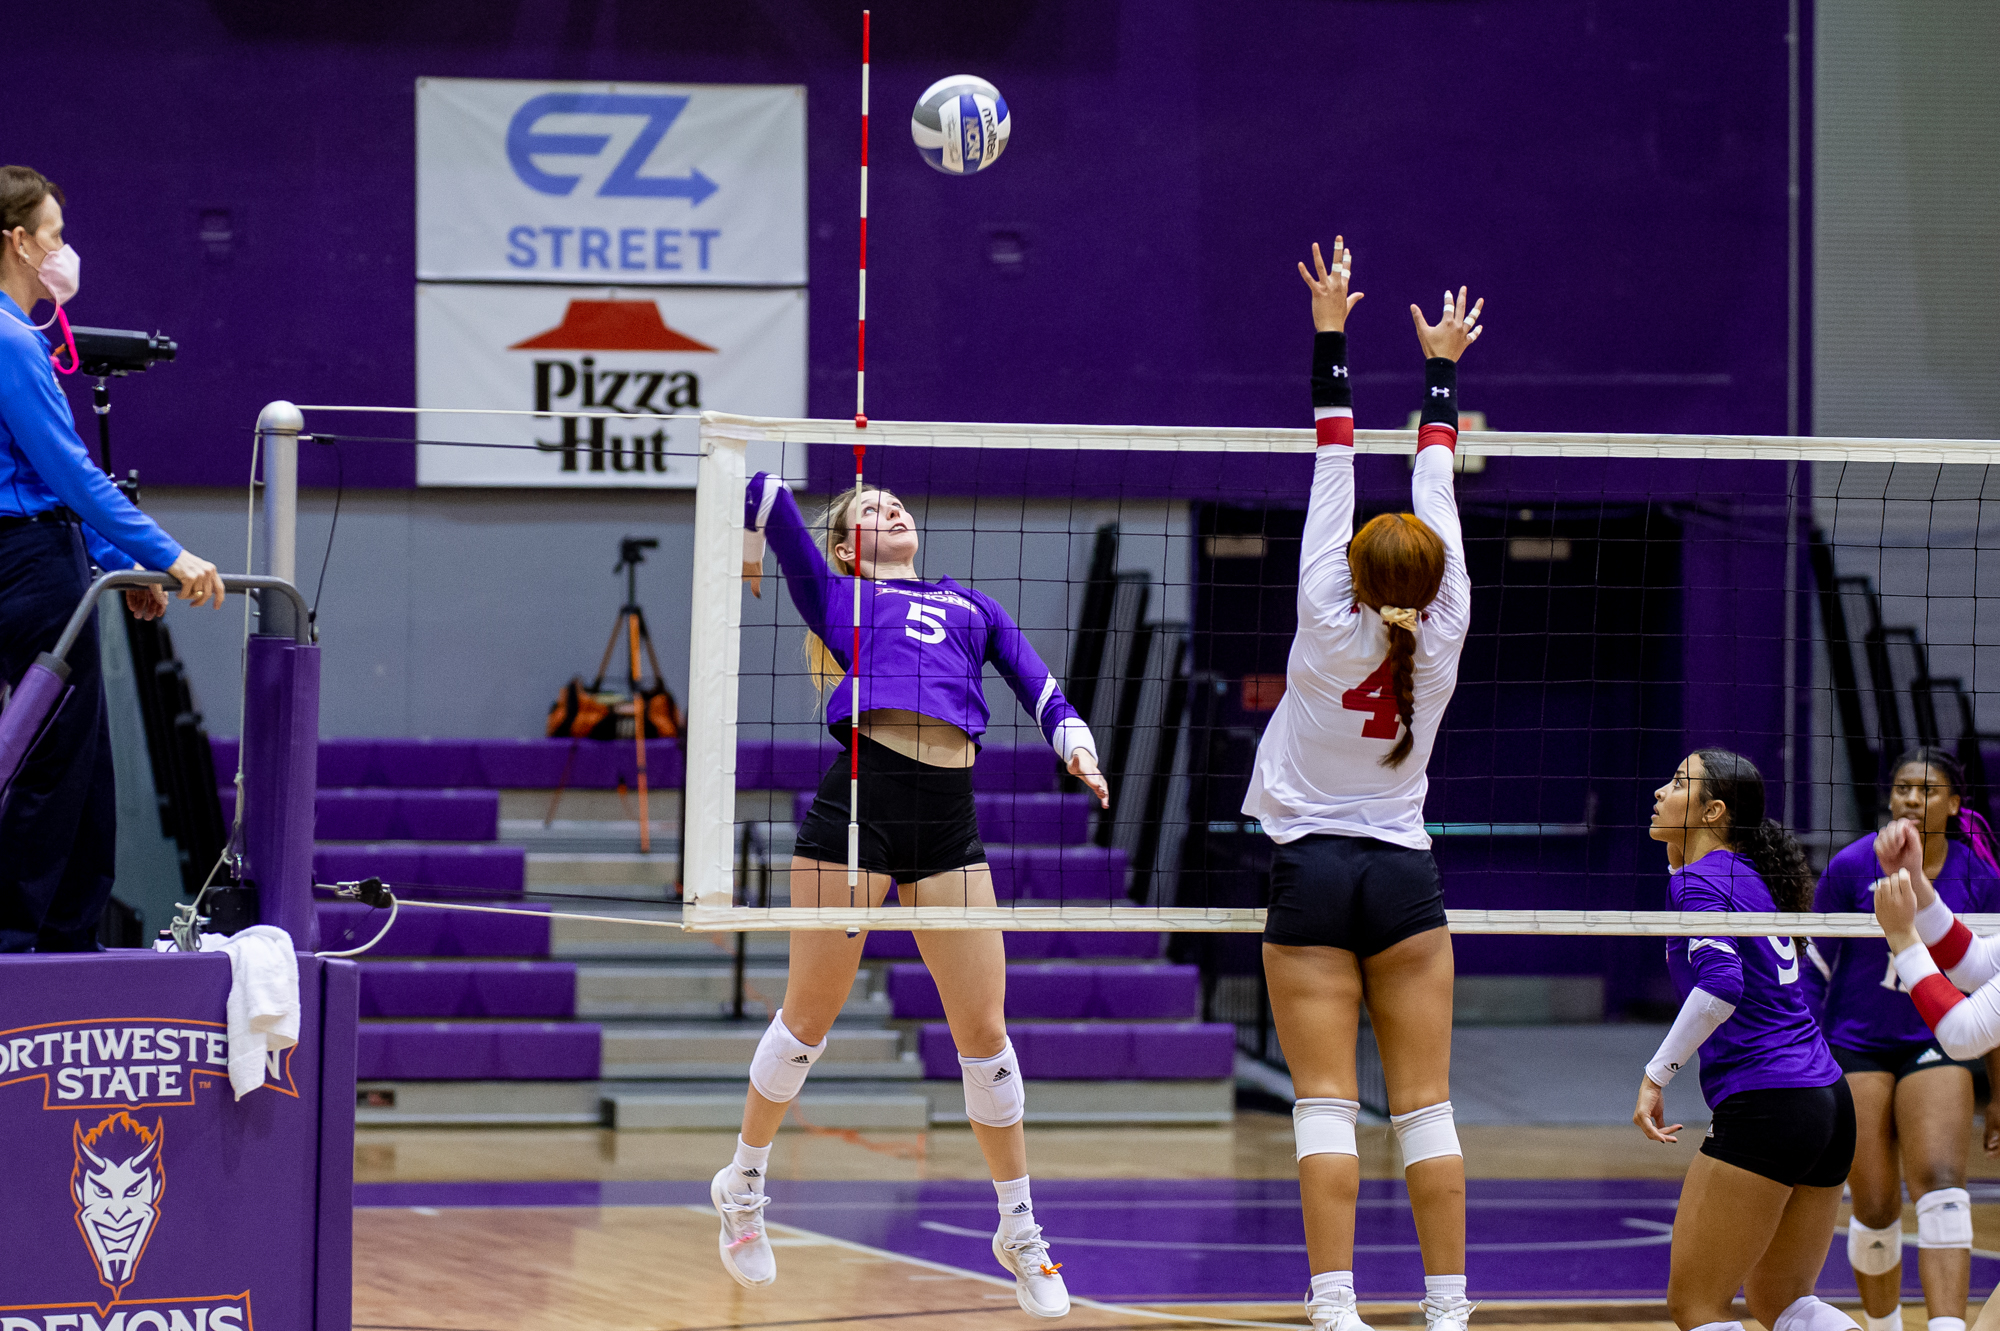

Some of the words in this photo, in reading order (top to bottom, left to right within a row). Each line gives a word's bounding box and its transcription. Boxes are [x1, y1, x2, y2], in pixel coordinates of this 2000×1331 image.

[505, 92, 719, 207] EZ
[982, 107, 998, 161] molten
[506, 225, 721, 271] STREET
[533, 357, 701, 419] Pizza
[535, 412, 672, 473] Hut
[905, 601, 947, 644] 5
[1341, 654, 1400, 740] 4
[1767, 936, 1799, 986] 9
[1879, 951, 1909, 993] 1
[57, 1065, 182, 1101] STATE
